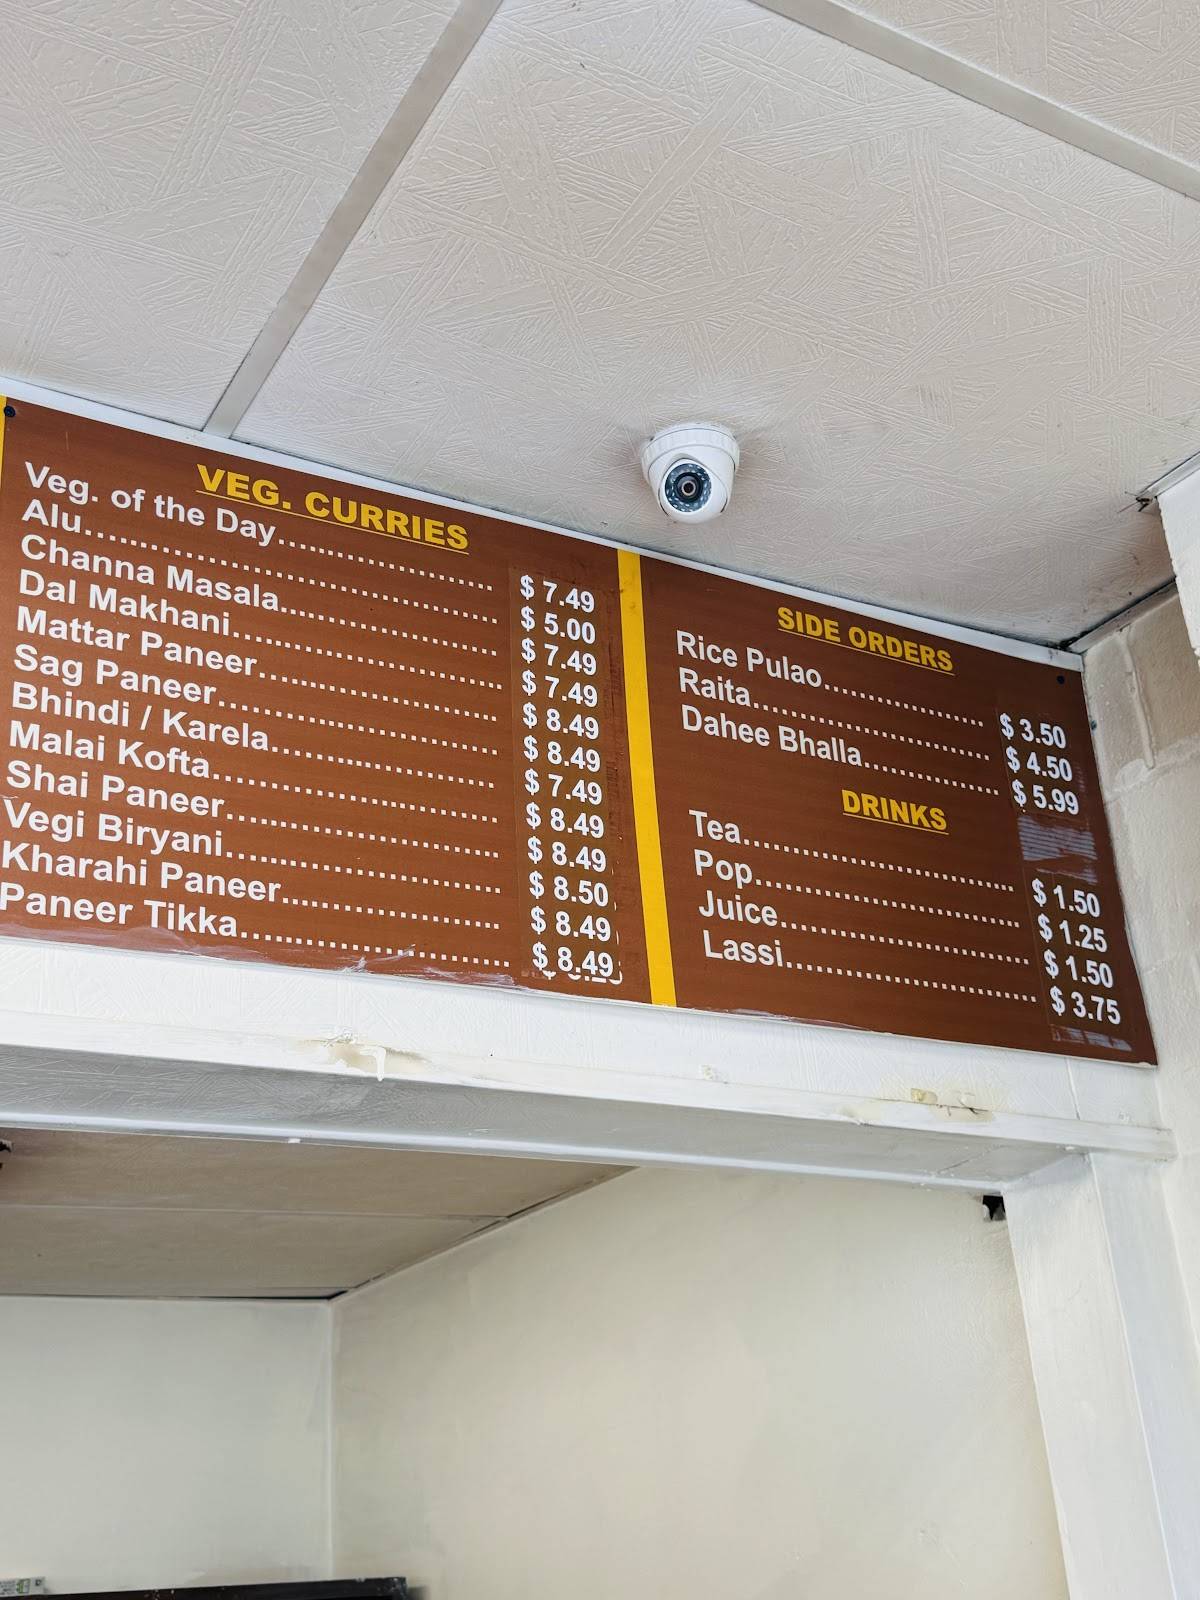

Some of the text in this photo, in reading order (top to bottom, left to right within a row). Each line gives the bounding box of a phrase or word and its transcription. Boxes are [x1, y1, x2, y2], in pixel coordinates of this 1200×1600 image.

[25, 461, 595, 613] Veg. of the Day $ 7.49
[197, 464, 470, 551] VEG. CURRIES
[20, 534, 597, 676] Channa Masala $ 7.49
[22, 498, 596, 644] Alu $ 5.00
[17, 605, 599, 740] Mattar Paneer $ 8.49
[19, 569, 598, 707] Dal Makhani $ 7.49
[676, 630, 1066, 749] Rice Pulao $ 3.50
[777, 606, 954, 673] SIDE ORDERS
[12, 681, 603, 805] Bhindi / Karela $ 7.49
[14, 643, 600, 773] Sag Paneer $ 8.49
[679, 667, 1073, 782] Raita $ 4.50
[681, 704, 1079, 815] Dahee Bhalla $ 5.99
[6, 760, 606, 872] Shai Paneer $ 8.49
[9, 720, 604, 839] Malai Kofta $ 8.49
[842, 789, 948, 832] DRINKS
[1, 840, 611, 942] Kharahi Paneer $ 8.49
[3, 799, 609, 907] Vegi Biryani $ 8.50
[688, 809, 1100, 918] Tea $ 1.50
[694, 849, 1108, 953] Pop $ 1.25
[0, 881, 613, 977] Paneer Tikka $ 8.49
[698, 890, 1114, 989] Juice $ 1.50
[703, 929, 1121, 1025] Lassi $ 3.75
